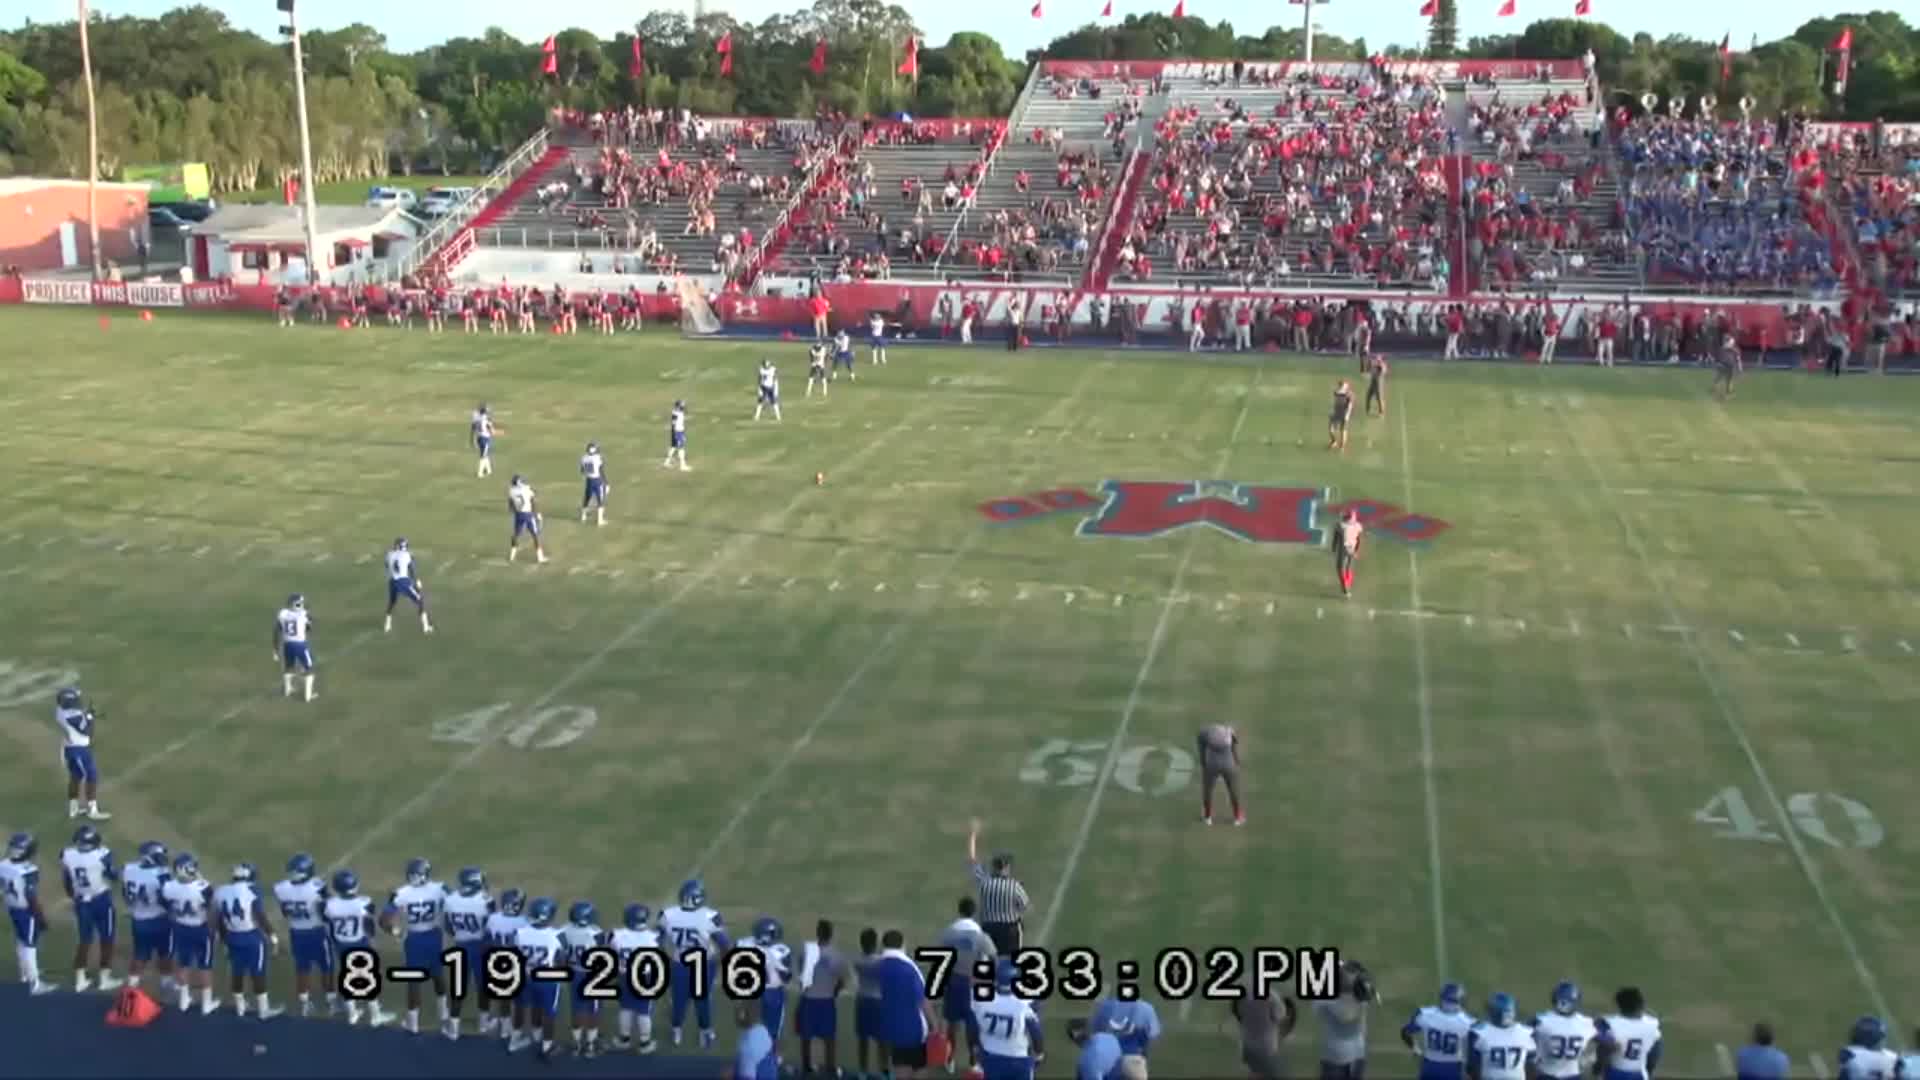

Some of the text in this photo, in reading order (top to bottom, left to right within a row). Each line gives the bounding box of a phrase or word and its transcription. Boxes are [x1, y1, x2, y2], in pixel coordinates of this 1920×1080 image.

[25, 281, 89, 301] PROTECT
[93, 284, 127, 302] THIS
[129, 285, 180, 303] HOUSE
[430, 701, 599, 749] 40
[1018, 739, 1195, 797] 50
[1694, 786, 1884, 850] 40
[407, 901, 435, 924] 52
[333, 916, 360, 938] 27
[671, 927, 700, 949] 75
[984, 1011, 1014, 1039] 77
[1550, 1034, 1585, 1060] 35
